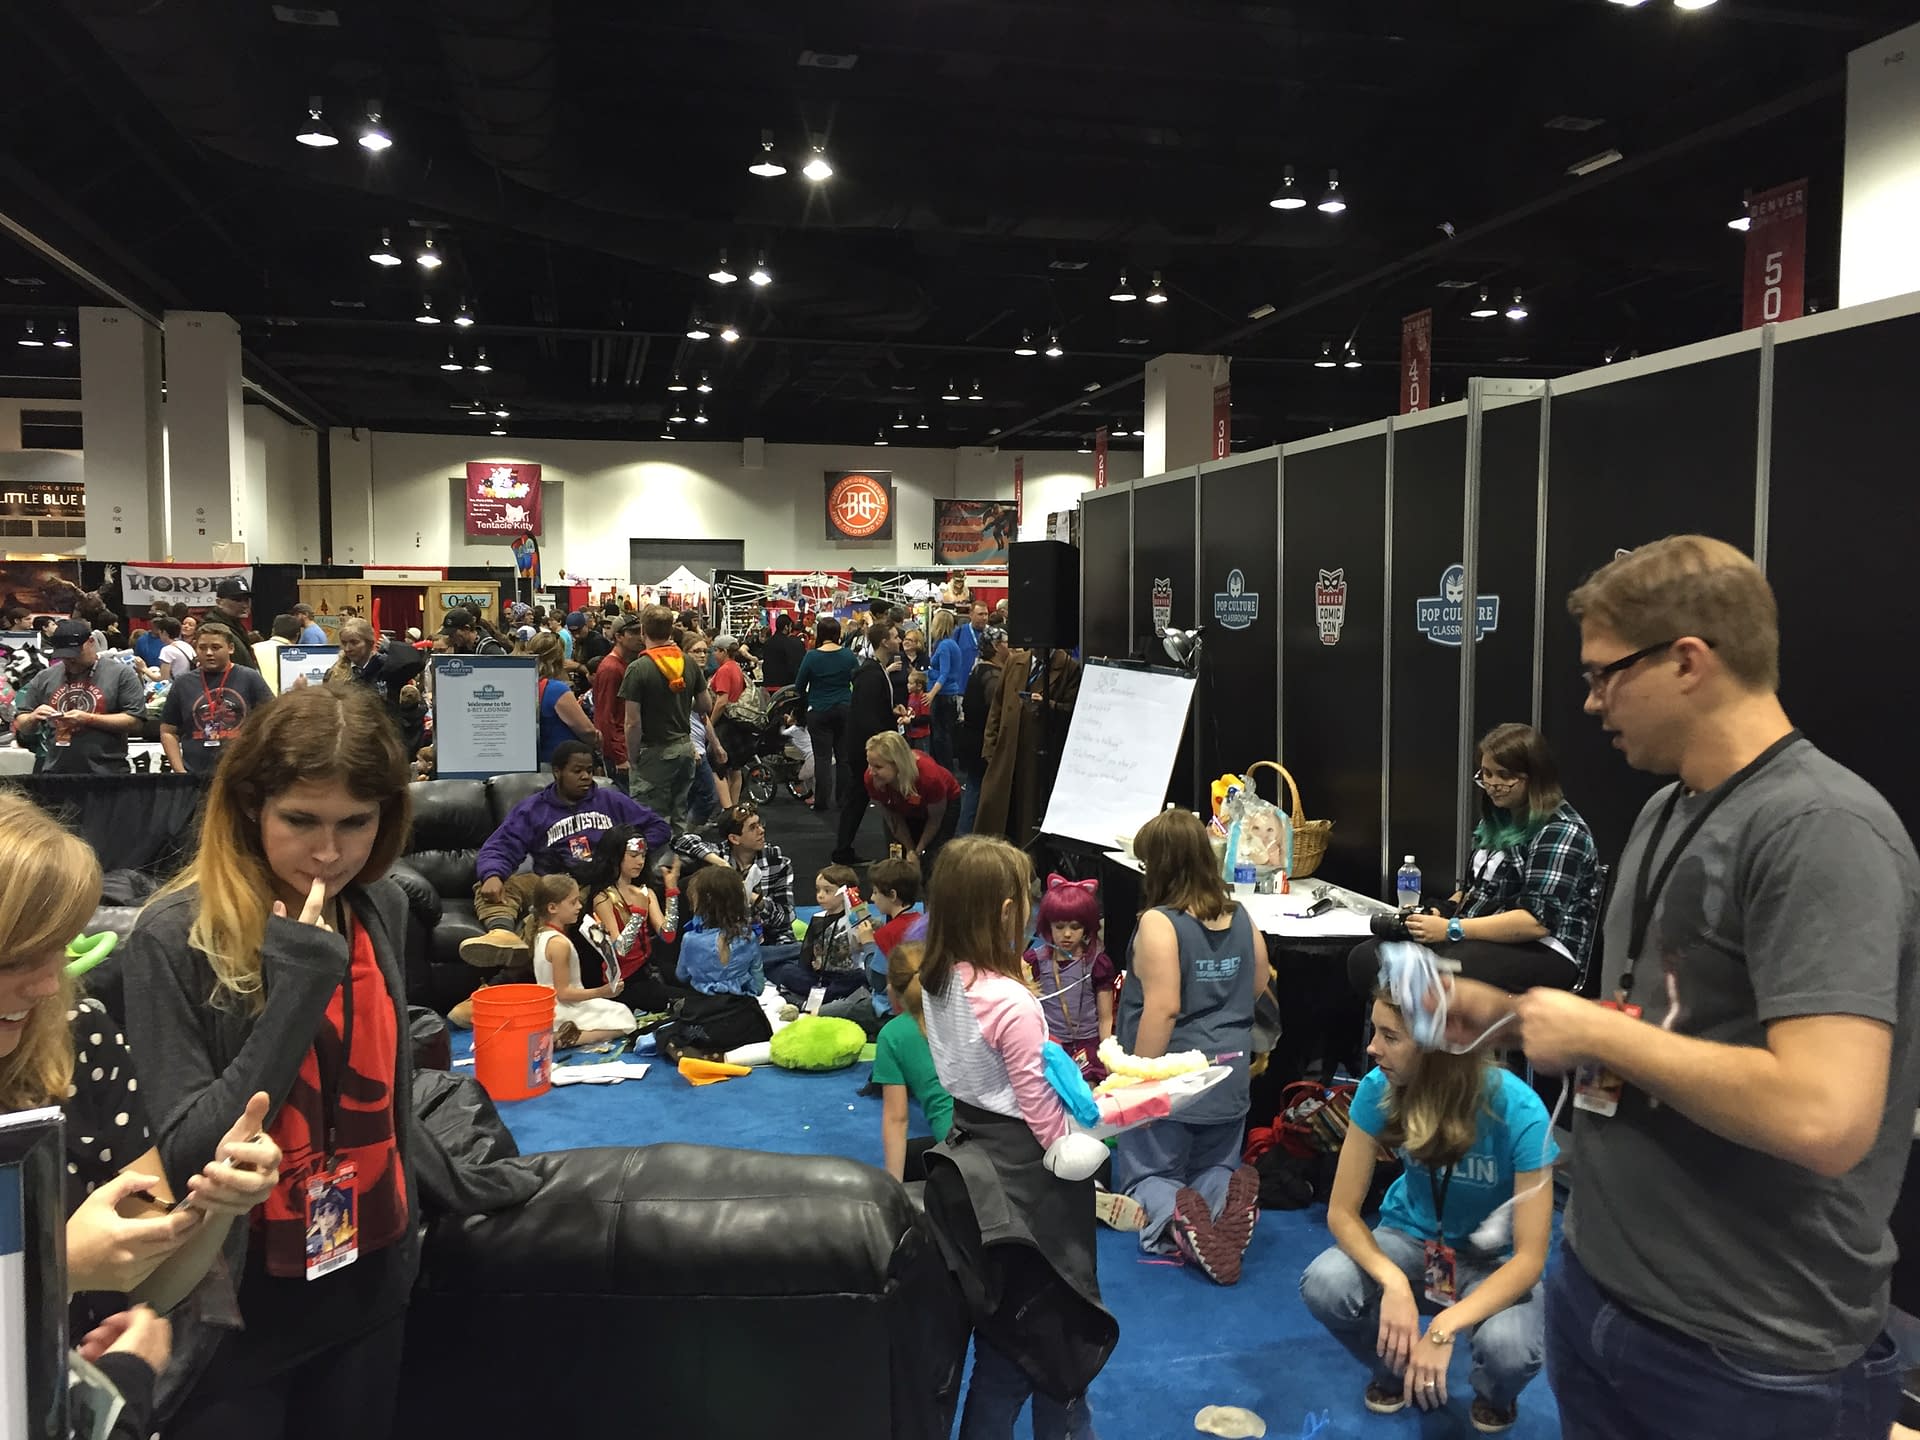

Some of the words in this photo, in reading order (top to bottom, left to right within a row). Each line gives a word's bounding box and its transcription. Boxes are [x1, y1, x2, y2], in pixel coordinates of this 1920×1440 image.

[0, 493, 40, 504] ITTLE
[43, 493, 79, 506] BLUE
[476, 520, 512, 529] Tentacle
[514, 522, 534, 531] Kitty
[1319, 595, 1343, 604] DENVER
[1217, 601, 1227, 611] POP
[1228, 600, 1256, 612] CULTURE
[1320, 608, 1341, 619] COMIC
[1421, 608, 1440, 621] POP
[1442, 606, 1493, 621] CULRE
[1323, 621, 1336, 632] CON
[1432, 625, 1478, 635] CLASSR
[1440, 1158, 1495, 1183] LIN
